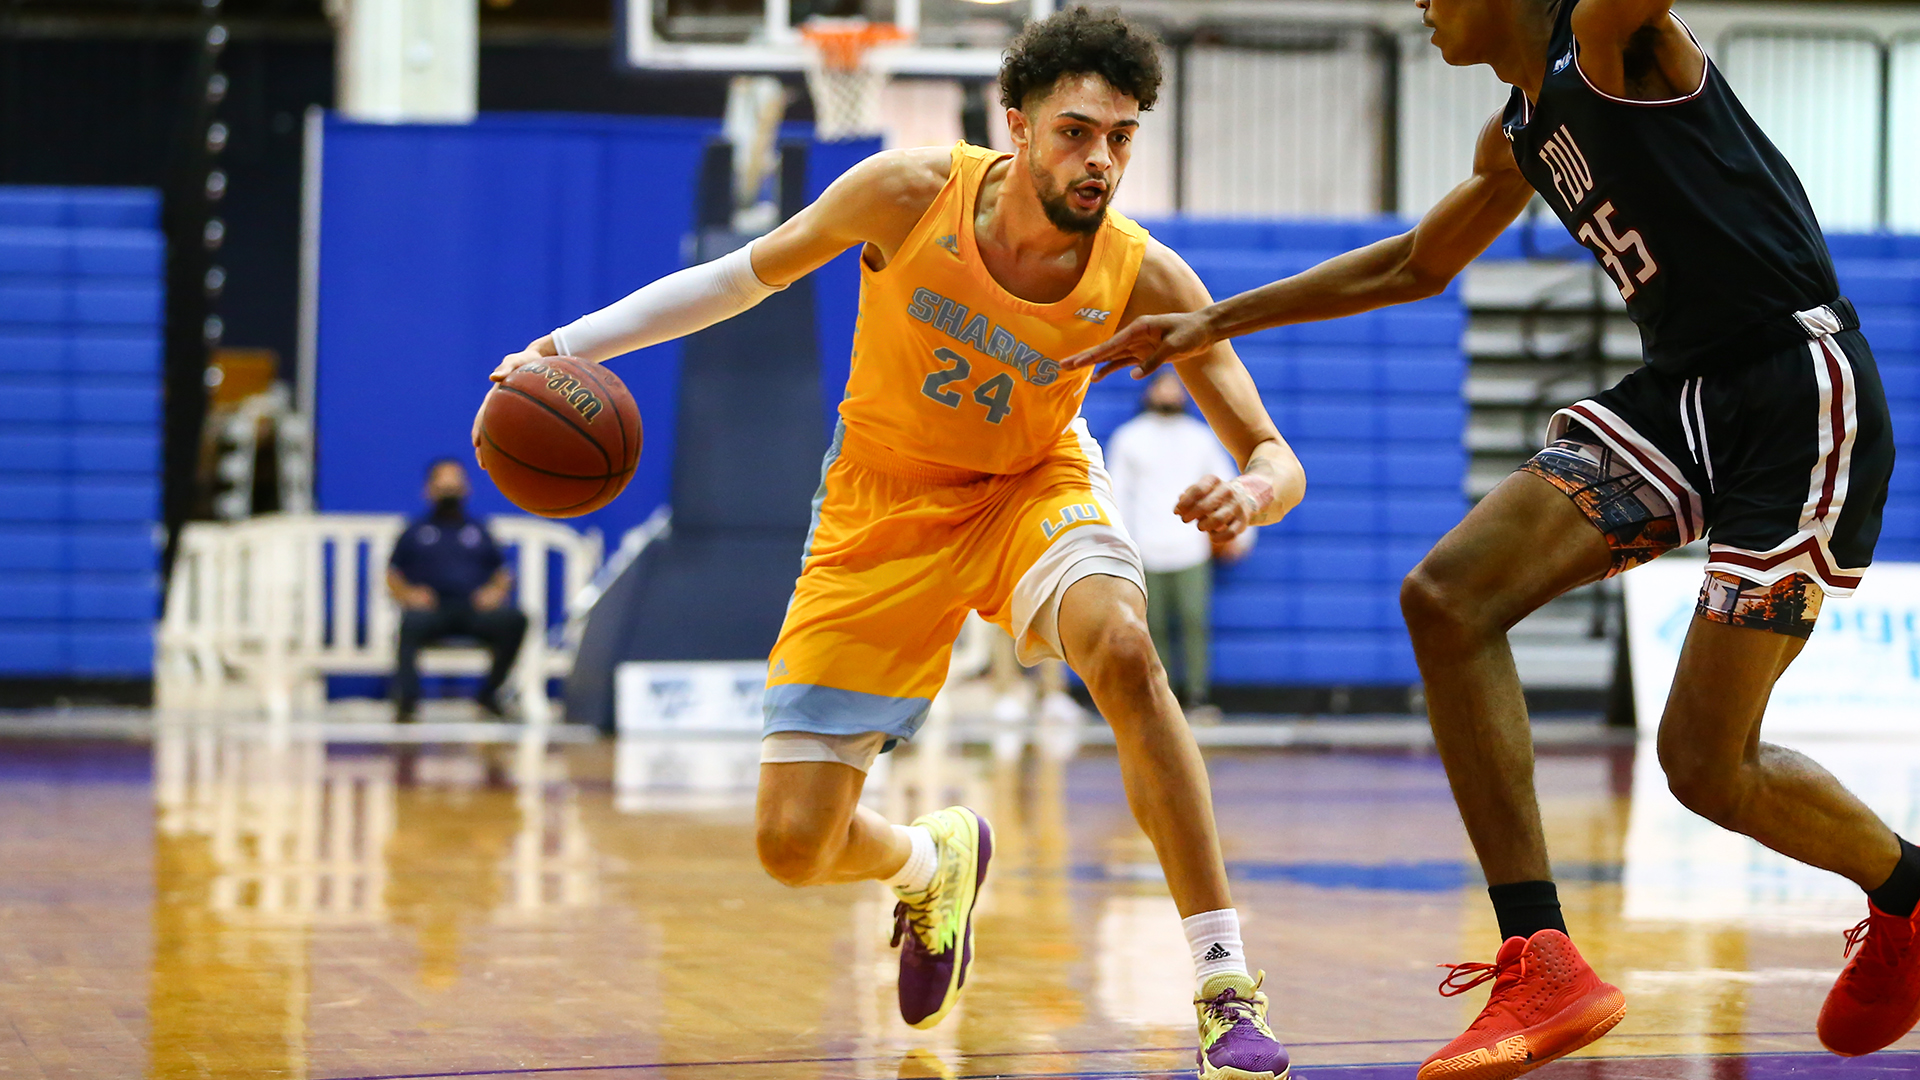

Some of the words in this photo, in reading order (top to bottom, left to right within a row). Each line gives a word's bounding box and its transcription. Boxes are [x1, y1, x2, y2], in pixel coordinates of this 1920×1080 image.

[1538, 124, 1594, 212] FDU
[1577, 200, 1658, 300] 35
[907, 287, 1062, 386] SHARKS
[1074, 307, 1111, 321] NEC
[519, 362, 604, 425] Wilson
[921, 346, 1015, 424] 24
[1040, 503, 1101, 541] LIU
[1204, 951, 1231, 961] adidas
